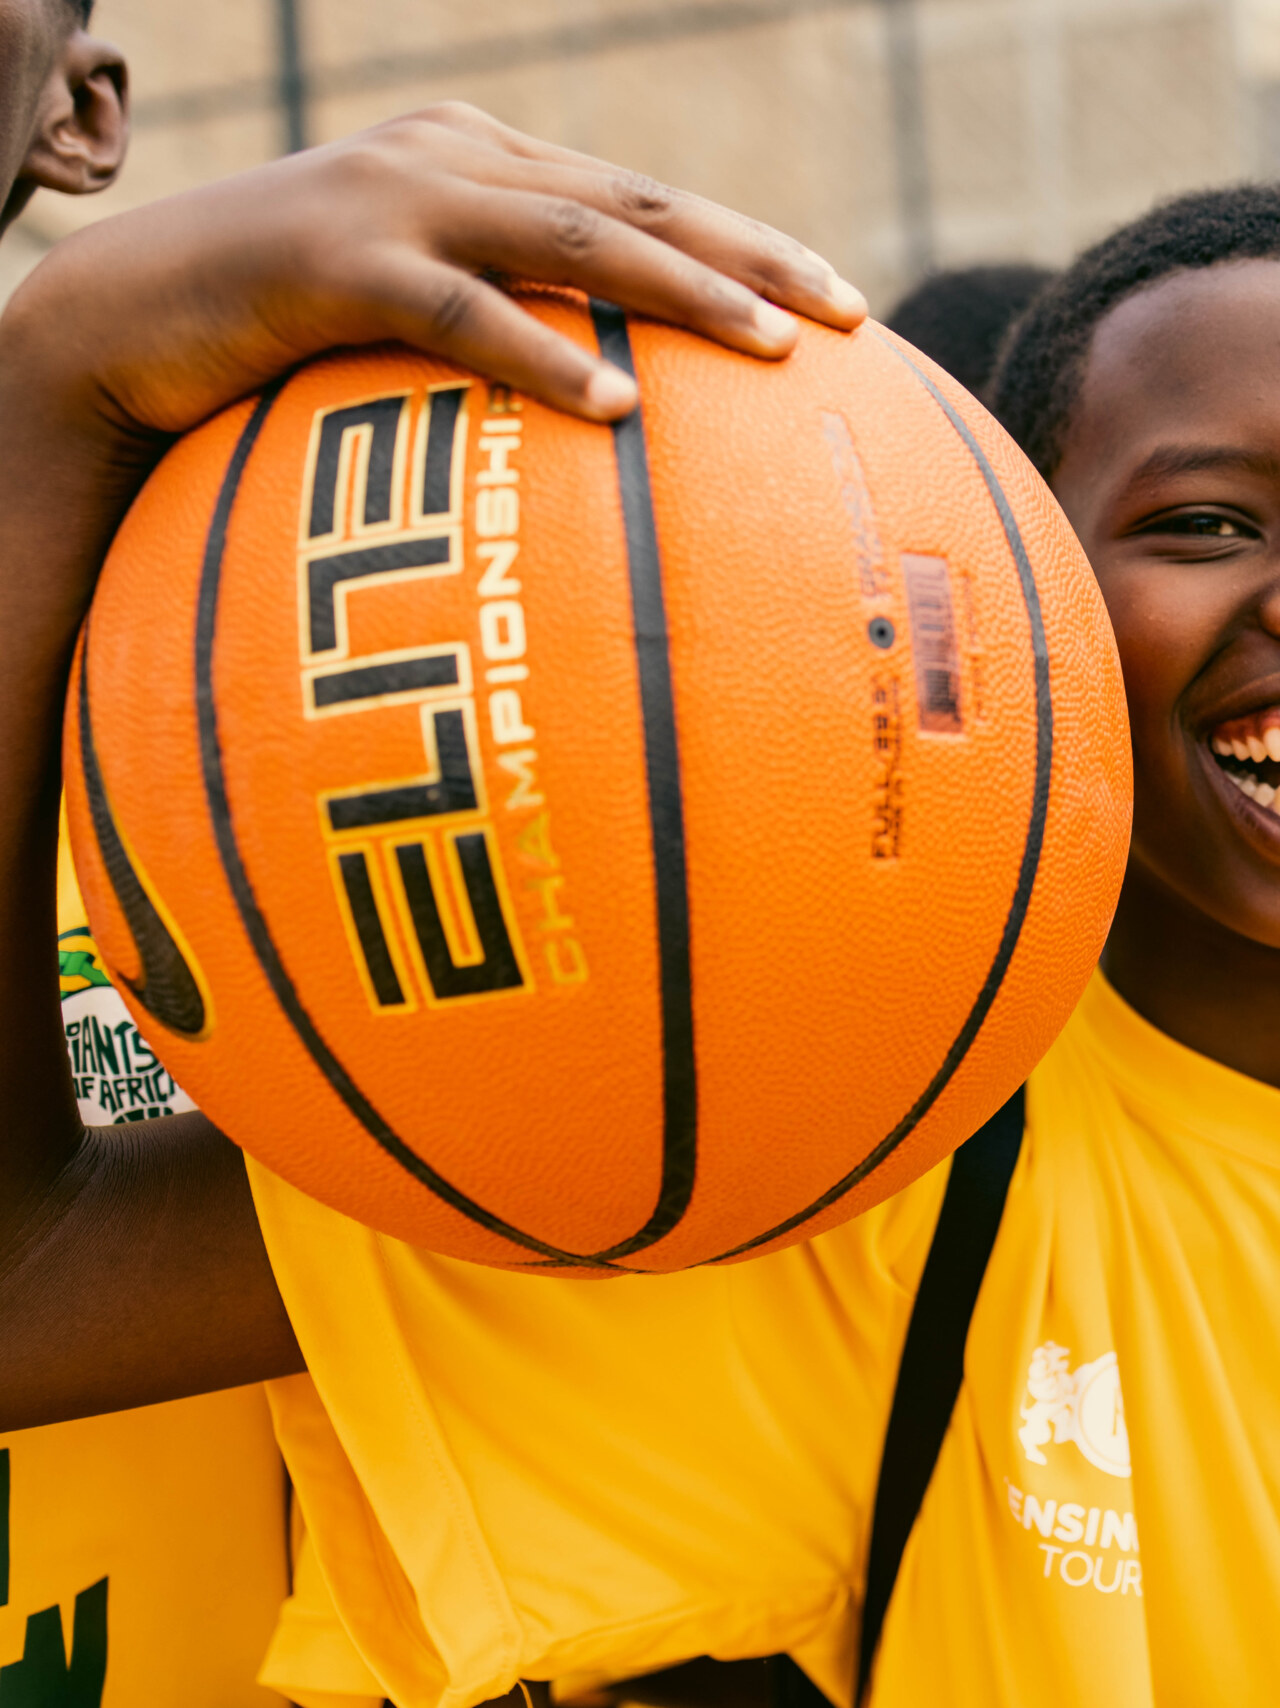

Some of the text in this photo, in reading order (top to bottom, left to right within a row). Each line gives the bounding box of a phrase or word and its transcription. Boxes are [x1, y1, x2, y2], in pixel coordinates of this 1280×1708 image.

[298, 379, 535, 1015] ELITE
[66, 1014, 160, 1077] IANTS
[1004, 1477, 1140, 1553] ENSIN
